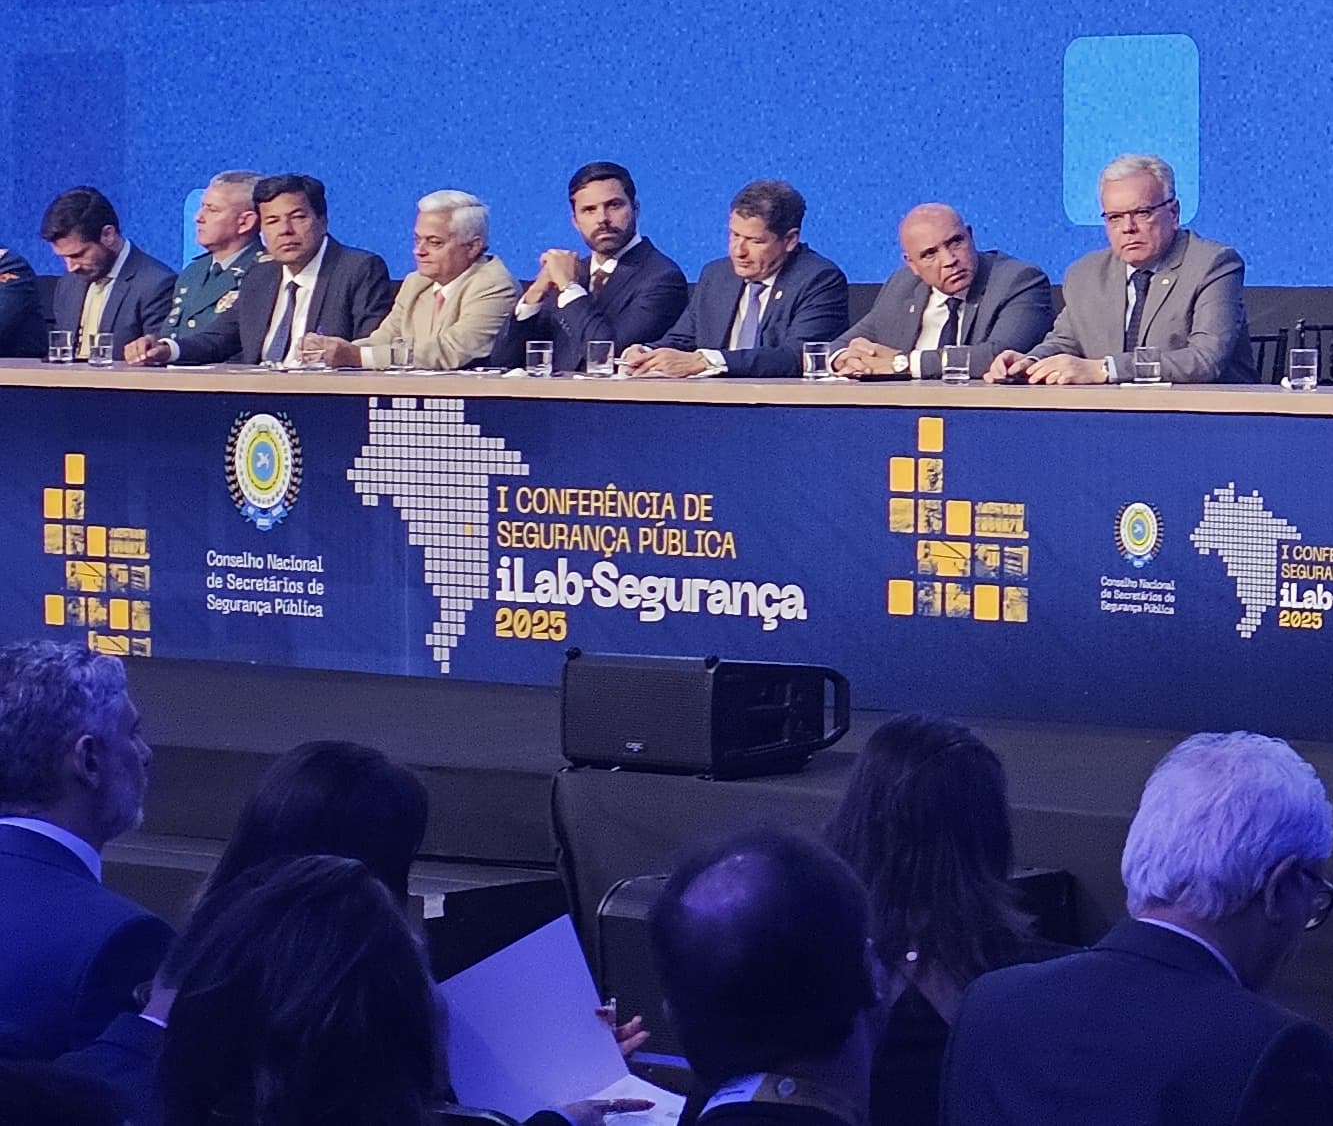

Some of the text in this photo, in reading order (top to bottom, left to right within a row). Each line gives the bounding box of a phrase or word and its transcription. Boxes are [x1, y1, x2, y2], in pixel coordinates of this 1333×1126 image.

[497, 483, 713, 521] I CONFERÊNCIA DE
[497, 521, 736, 558] SEGURANÇA PÚBLICA
[207, 550, 323, 572] Conselho Nacional
[1281, 545, 1288, 558] I
[207, 573, 323, 594] de Secretários de
[496, 556, 807, 630] iLab-Segurança
[207, 594, 323, 617] Segurança Pública
[495, 608, 566, 641] 2025
[1279, 610, 1322, 628] 2025
